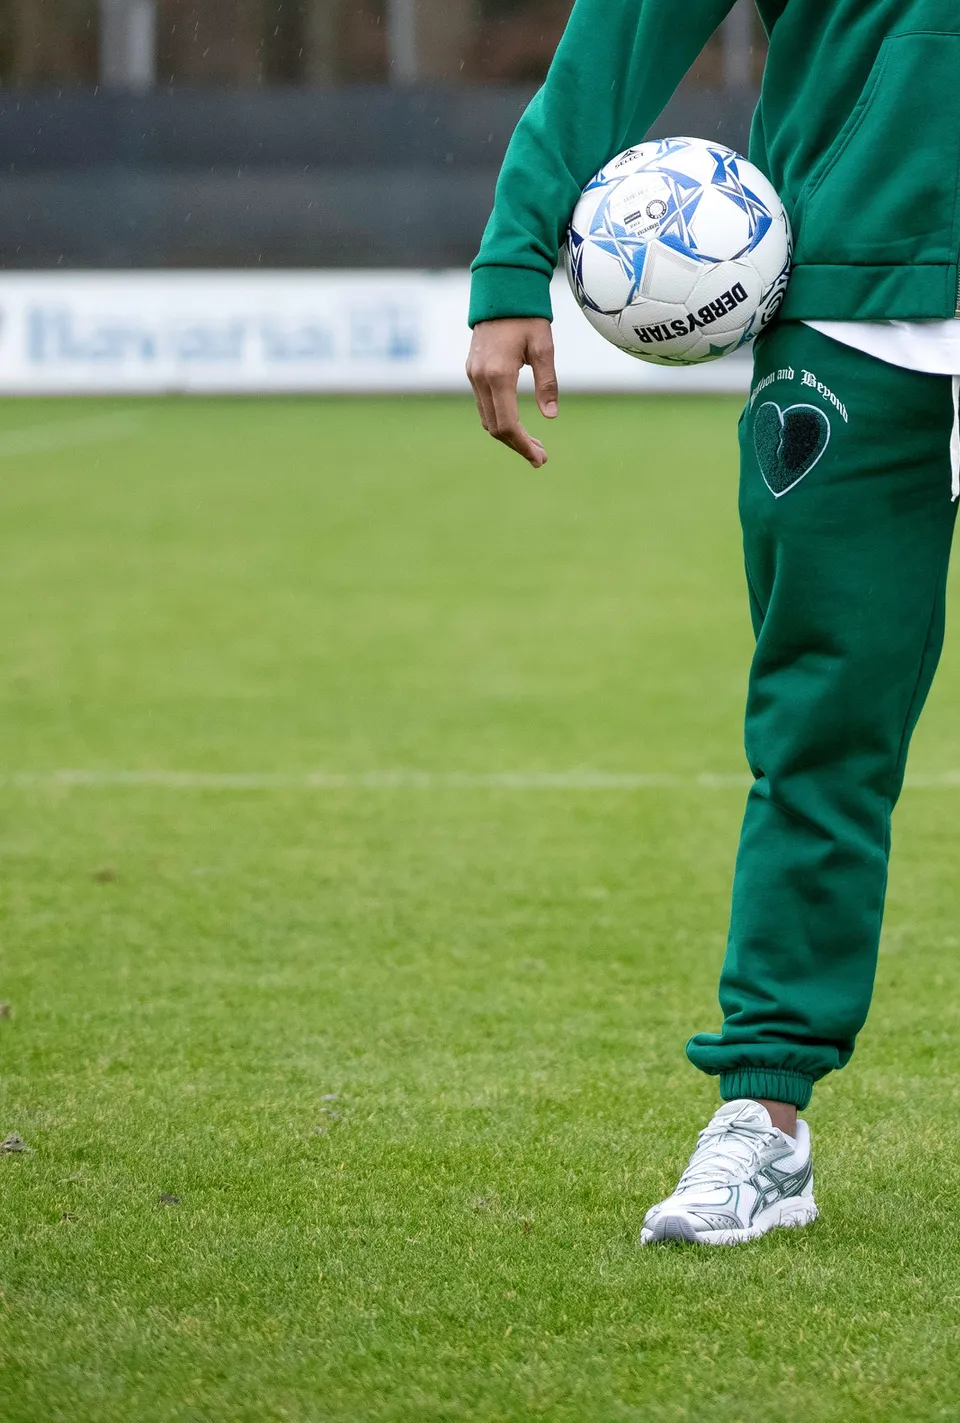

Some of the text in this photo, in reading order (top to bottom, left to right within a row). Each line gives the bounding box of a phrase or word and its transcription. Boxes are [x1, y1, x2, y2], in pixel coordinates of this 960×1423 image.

[613, 151, 645, 170] SELECT
[634, 281, 749, 344] DERBYSTAR
[776, 365, 795, 381] and
[800, 369, 849, 424] Beyond
